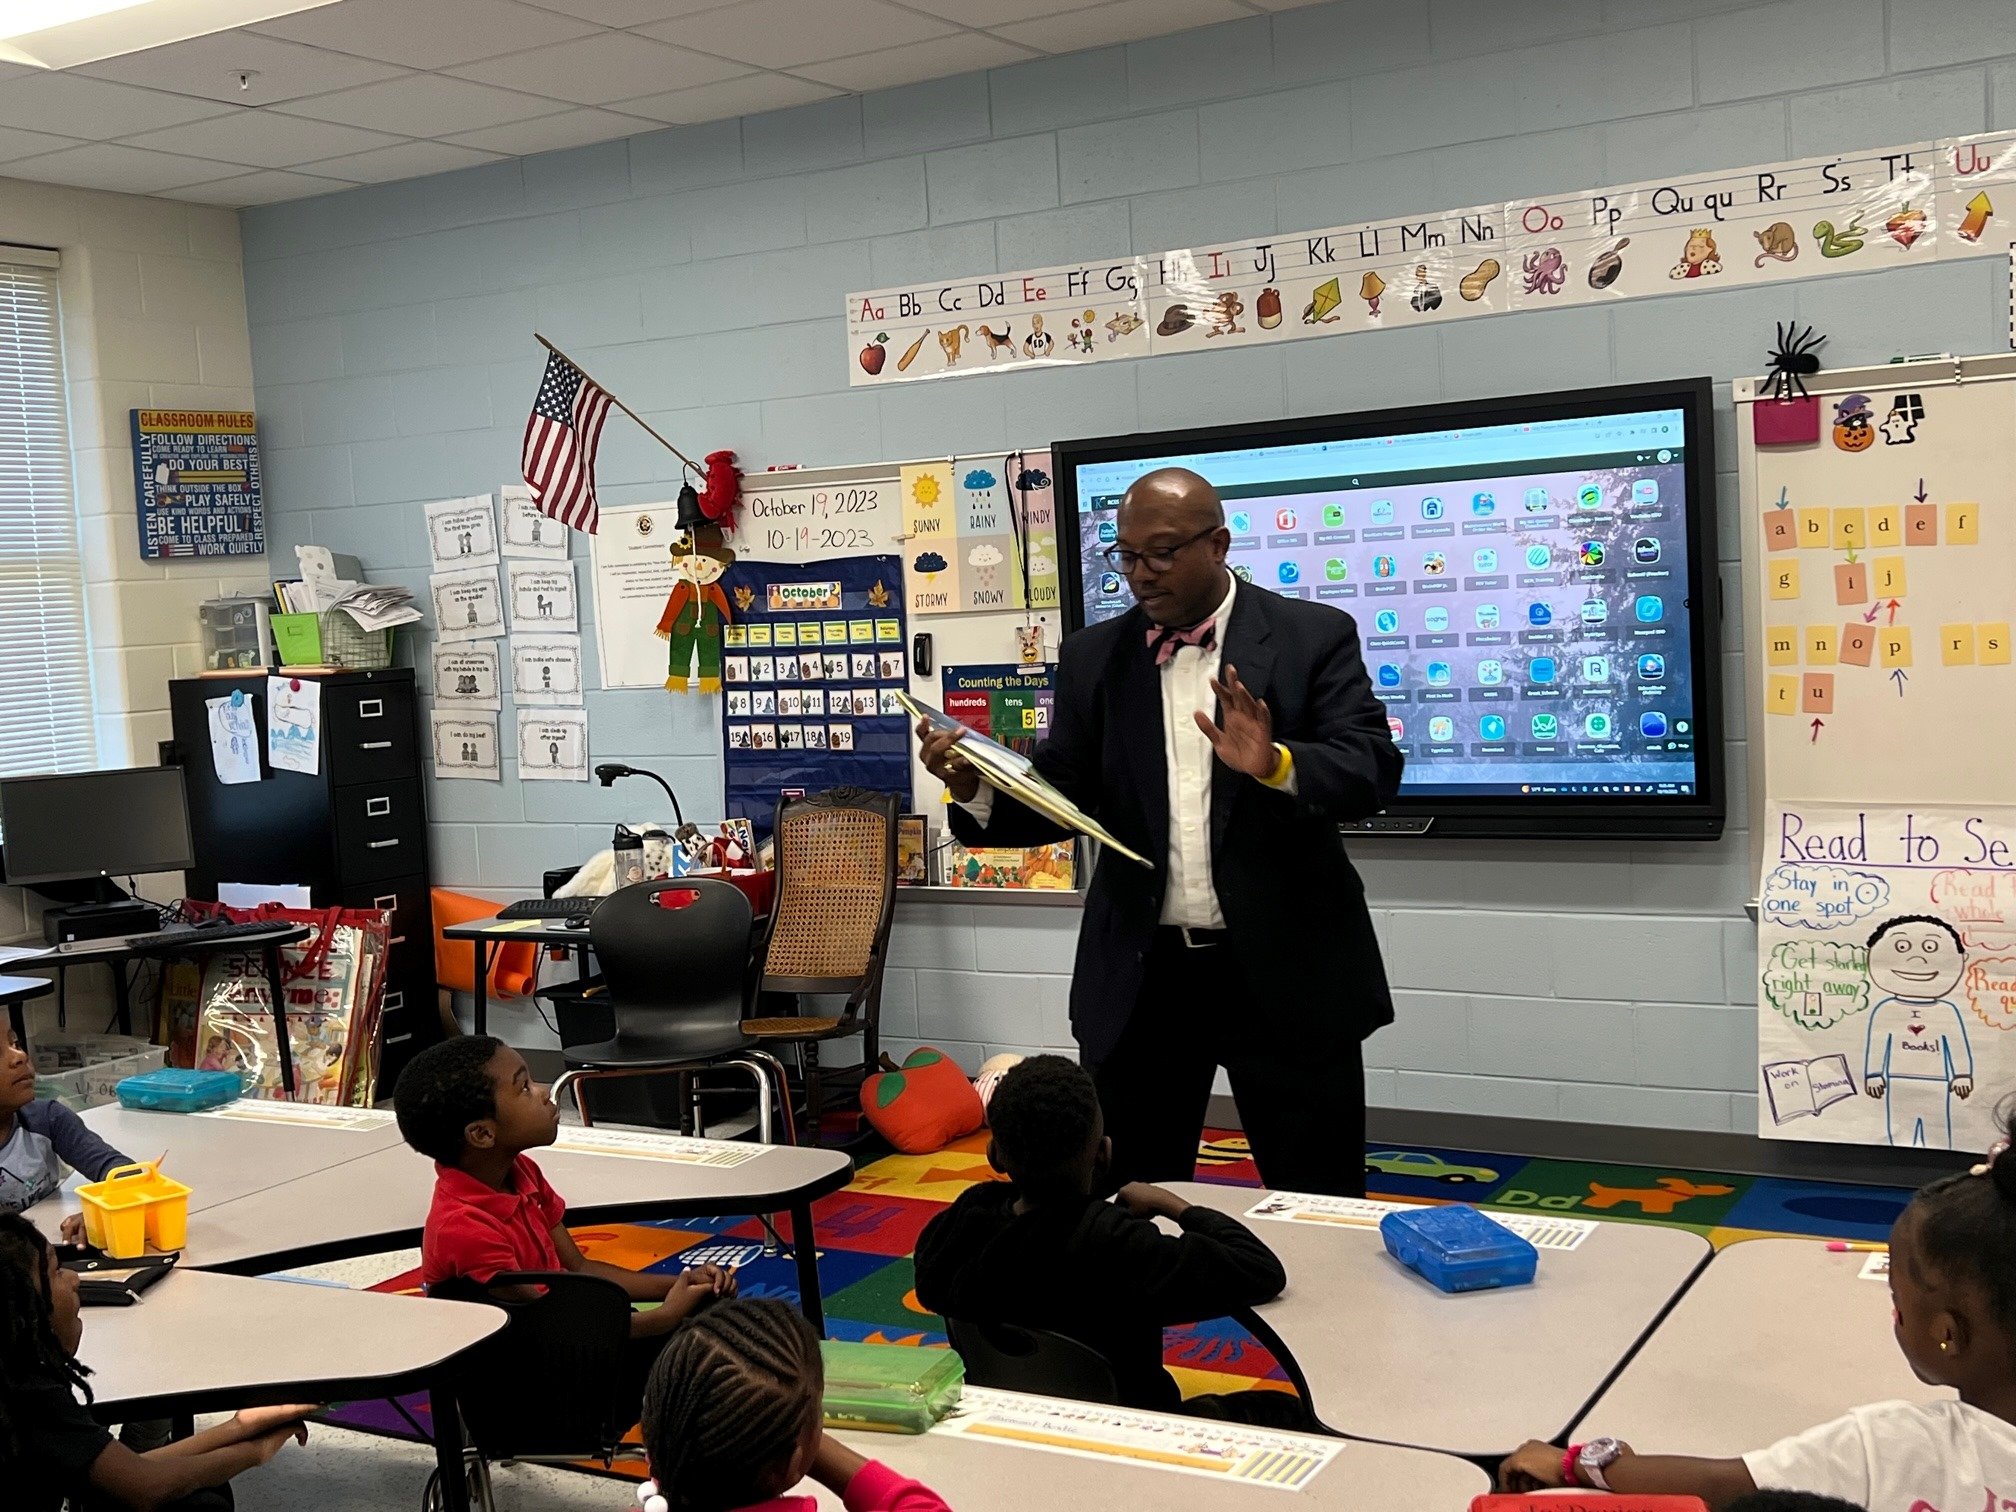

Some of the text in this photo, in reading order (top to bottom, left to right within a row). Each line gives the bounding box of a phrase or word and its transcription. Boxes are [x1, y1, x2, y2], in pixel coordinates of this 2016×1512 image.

[860, 299, 885, 323] Aa
[899, 293, 922, 318] Bb
[938, 287, 962, 312] Cc
[978, 281, 1005, 308] Dd
[1022, 277, 1047, 303] Ee
[1067, 270, 1090, 297] Ff
[1105, 265, 1139, 300] Gg
[1207, 252, 1231, 279] Ii
[1254, 244, 1276, 284] Jj
[1307, 236, 1336, 265] Kk
[1359, 230, 1380, 258] Ll
[1400, 222, 1446, 252] Mm
[1461, 214, 1494, 244] Nn
[1522, 205, 1564, 234] Oo
[1592, 197, 1622, 236] Pp
[1652, 187, 1694, 216] Qu
[1704, 192, 1734, 222] qu
[1758, 174, 1788, 202] Rr
[1822, 163, 1852, 195] Ss
[1880, 153, 1915, 184] Tt
[1955, 144, 1991, 176] Uu
[1033, 338, 1045, 350] ED
[140, 412, 254, 428] CLASSROOM RULES
[151, 434, 257, 446] FOLLOW DIRECTIONS
[152, 445, 171, 453] COME
[173, 445, 194, 453] READY
[169, 459, 249, 471] DO YOUR BEST
[139, 432, 160, 558] LISTEN CAREFULLY
[155, 484, 242, 493] THINK OUTSIDE THE BOX
[248, 446, 264, 541] RESPECT OTHERS
[185, 493, 252, 507] PLAY SAFELY
[752, 489, 878, 519] October 19, 2023
[189, 507, 211, 515] WORDS
[213, 507, 226, 515] AND
[227, 506, 252, 515] ACTIONS
[157, 514, 242, 535] BE HELPFUL
[913, 509, 1051, 534] SUNNY RAINY WINDY
[1775, 514, 1968, 536] a b c d e f
[158, 532, 254, 545] COME TO CLASS PREPARED
[767, 526, 875, 551] 10-19-2023
[198, 541, 264, 556] WORK QUIETLY
[1779, 569, 1893, 590] g i j
[782, 586, 829, 599] October
[915, 586, 1057, 608] STORMY SNOWY LOUDY
[1774, 638, 1999, 656] m n o p r s
[738, 660, 900, 675] 1 2 3 4 5 6 7
[958, 675, 1050, 690] Counting the Days
[1779, 687, 1823, 700] t u
[740, 697, 747, 709] 8
[755, 697, 762, 709] 9
[788, 696, 800, 708] 10
[812, 697, 821, 708] 11
[831, 696, 842, 708] 12
[863, 696, 875, 707] 13
[949, 697, 1055, 708] hundreds tens one
[1024, 711, 1047, 726] 5 2
[730, 731, 851, 743] 15 16 17 18 19
[1780, 812, 1868, 862] Read
[1899, 813, 1940, 863] to
[1778, 869, 1849, 897] Stay in
[1944, 873, 1996, 898] Read
[1766, 896, 1854, 919] one spot
[1781, 946, 1819, 970] Get
[1772, 971, 1861, 1004] right away
[1910, 1010, 1922, 1019] I
[1901, 1039, 1940, 1056] Books!
[1770, 1067, 1800, 1080] Work
[1784, 1080, 1800, 1090] on
[1495, 1188, 1584, 1211] Dd
